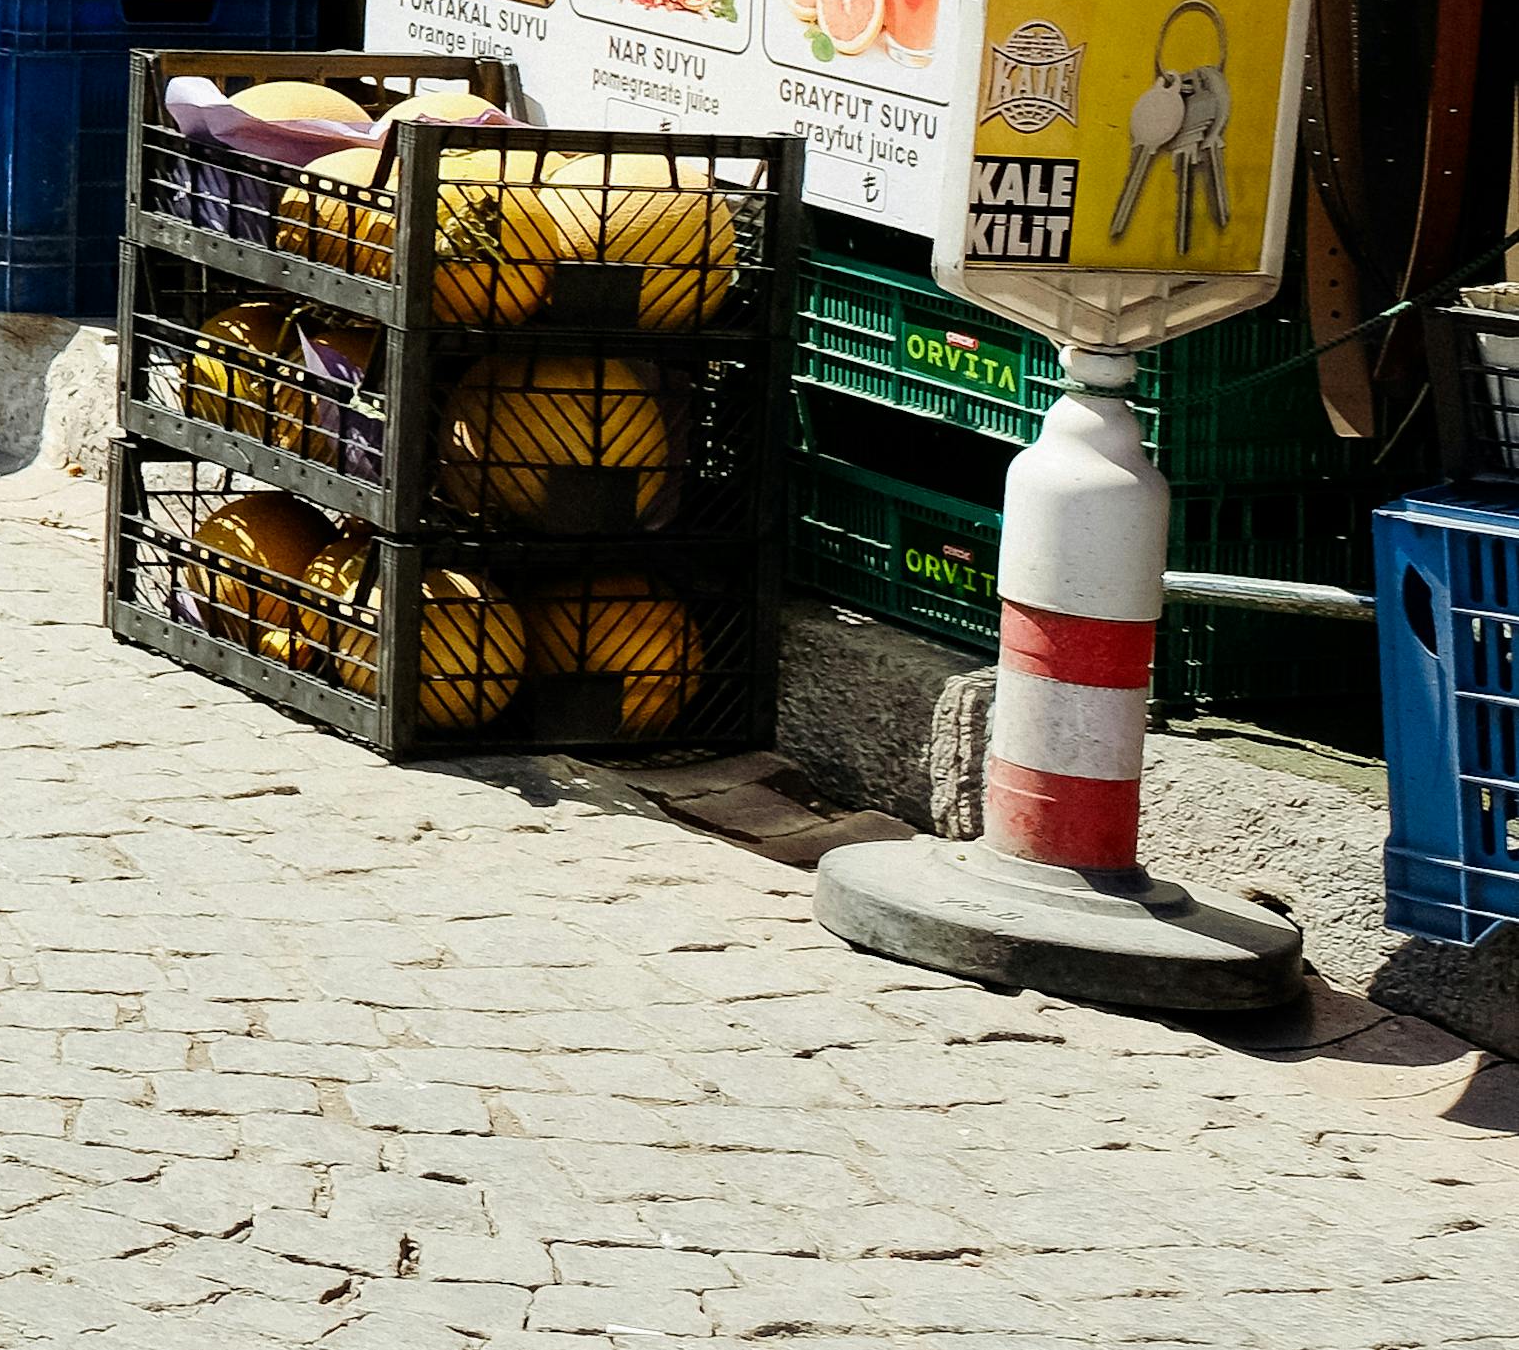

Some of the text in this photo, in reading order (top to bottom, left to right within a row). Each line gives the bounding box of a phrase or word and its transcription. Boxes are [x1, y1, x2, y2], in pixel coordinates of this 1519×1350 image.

[408, 22, 513, 59] orange juice
[497, 9, 548, 41] SUYU
[607, 35, 707, 81] NAR SUYU
[994, 53, 1077, 107] KALE
[593, 66, 720, 115] pomegranate juice
[779, 78, 937, 140] GRAYFUT SUYU
[868, 133, 919, 168] juice
[972, 160, 1075, 208] KALE
[967, 213, 1072, 258] KİLİT
[906, 333, 1017, 393] ORVITA
[905, 547, 996, 598] ORVIT
